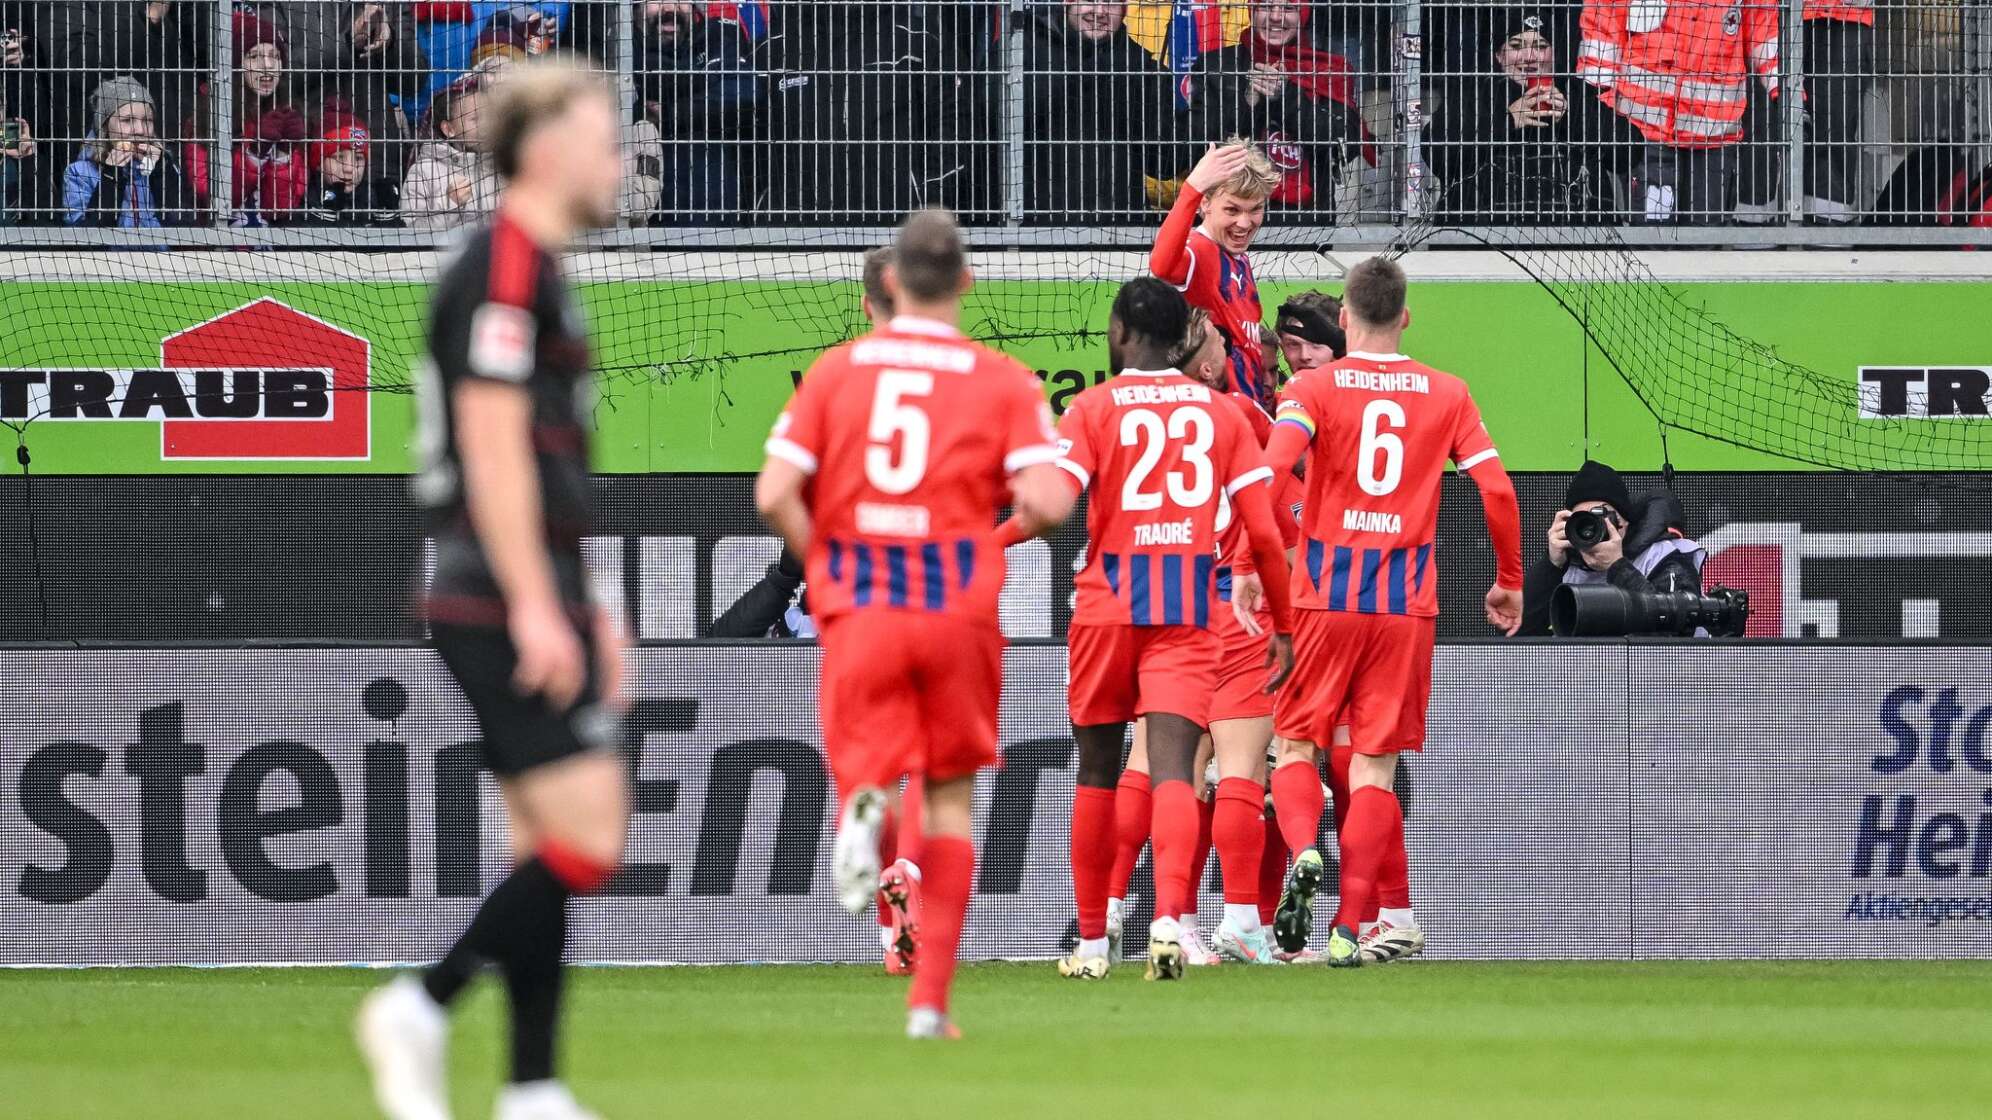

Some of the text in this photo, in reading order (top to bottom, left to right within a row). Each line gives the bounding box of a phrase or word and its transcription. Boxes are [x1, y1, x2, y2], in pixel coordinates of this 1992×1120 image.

[0, 371, 329, 418] TRAUB
[1111, 384, 1212, 406] HEIDENHEIM
[1334, 369, 1430, 394] HEIDENHEIM
[864, 369, 934, 495] 5
[1356, 399, 1406, 496] 6
[1119, 406, 1215, 511] 23
[1134, 518, 1193, 546] TRAORÉ
[1343, 509, 1401, 534] MAINKA
